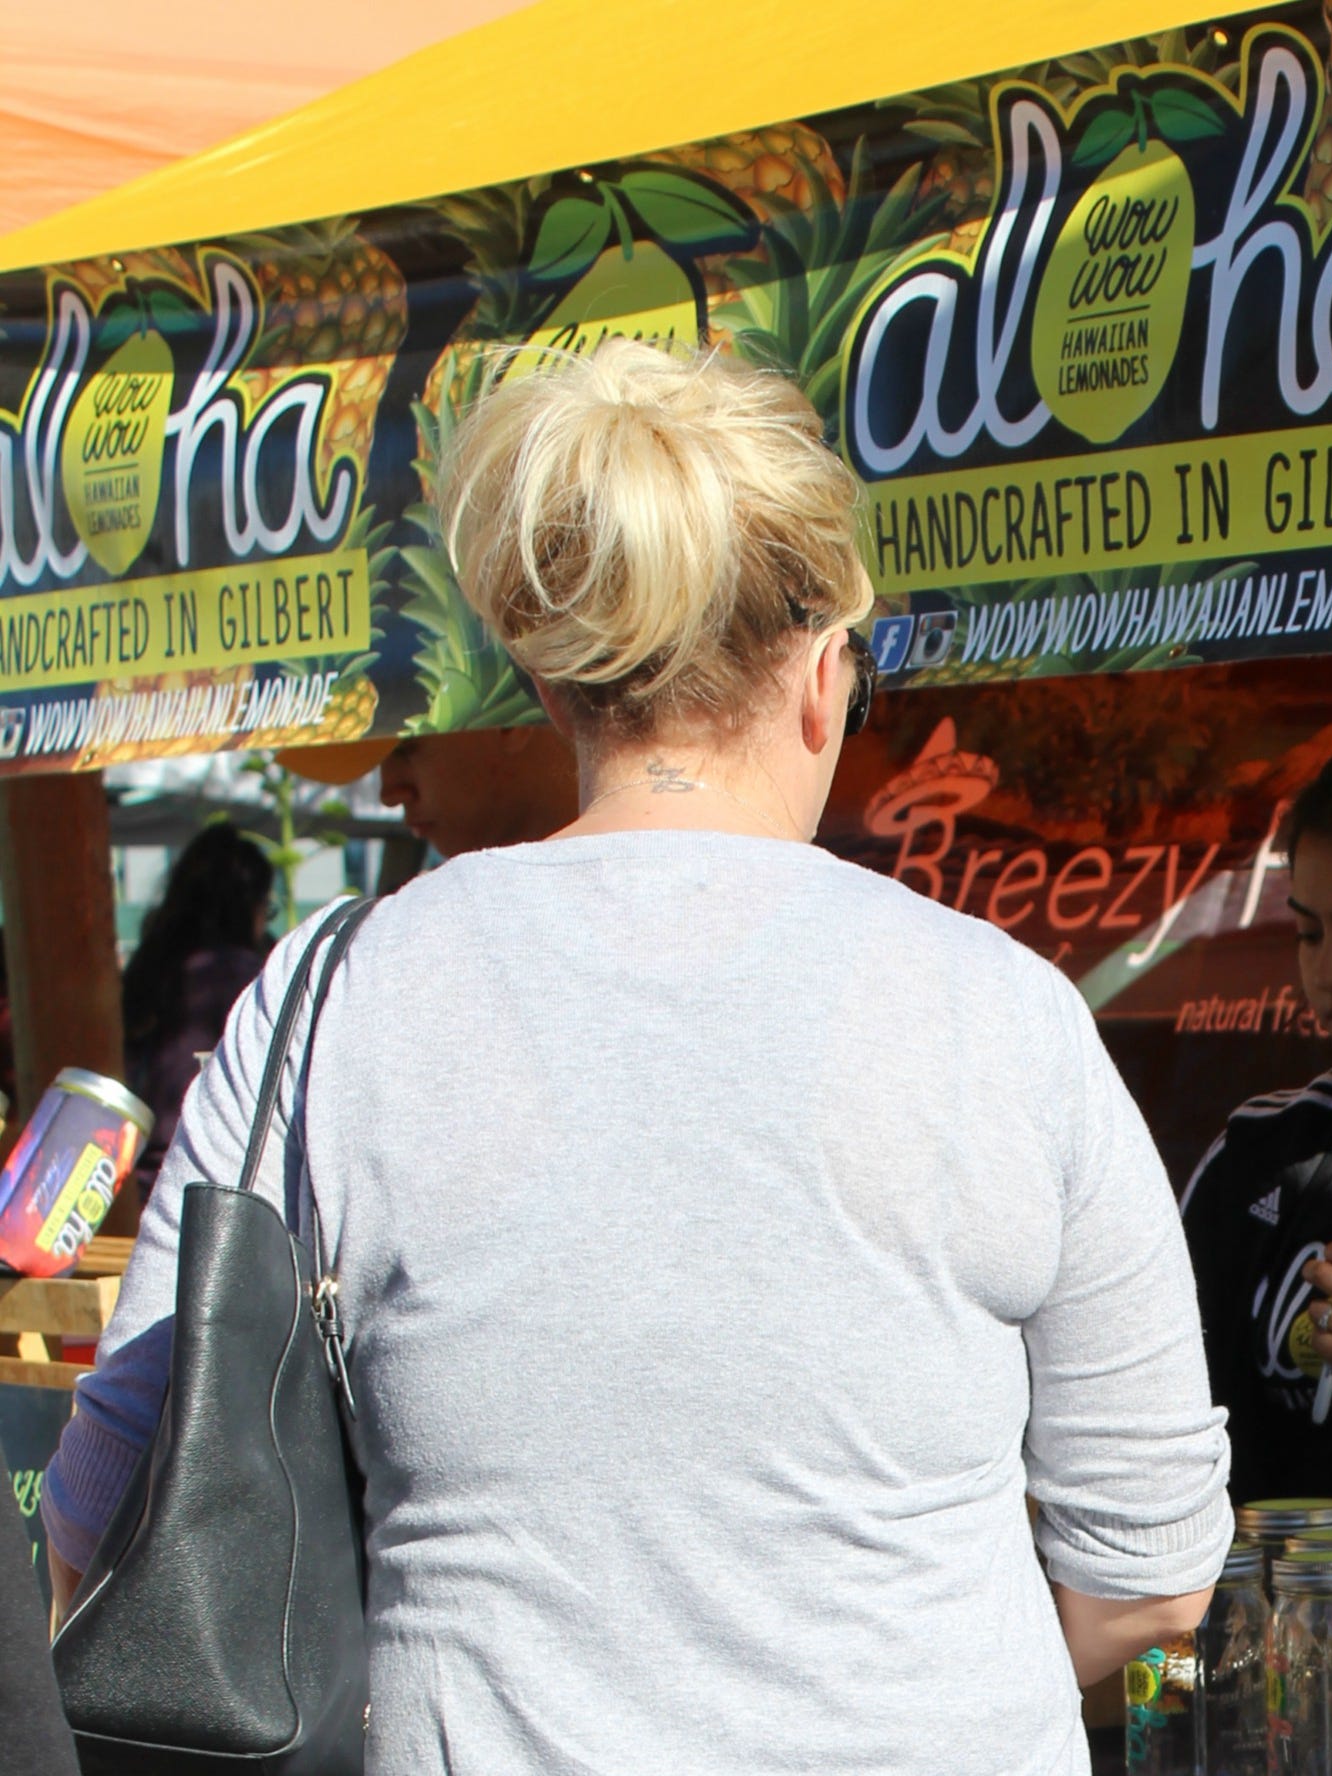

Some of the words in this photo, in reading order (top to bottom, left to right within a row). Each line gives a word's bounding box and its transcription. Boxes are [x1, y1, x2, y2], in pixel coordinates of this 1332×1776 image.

[1060, 318, 1149, 361] HAWAIIAN
[1058, 357, 1149, 396] LEMONADES
[0, 261, 352, 586] loha
[84, 474, 140, 502] HAWAIIAN
[876, 469, 1151, 577] HANDCRAFTED
[1174, 458, 1230, 545] IN
[87, 504, 141, 537] LEMONADES
[163, 589, 198, 658] IN
[218, 568, 355, 651] GILBERT
[25, 670, 340, 755] WOWWOWHAWAIIANLEMONADE
